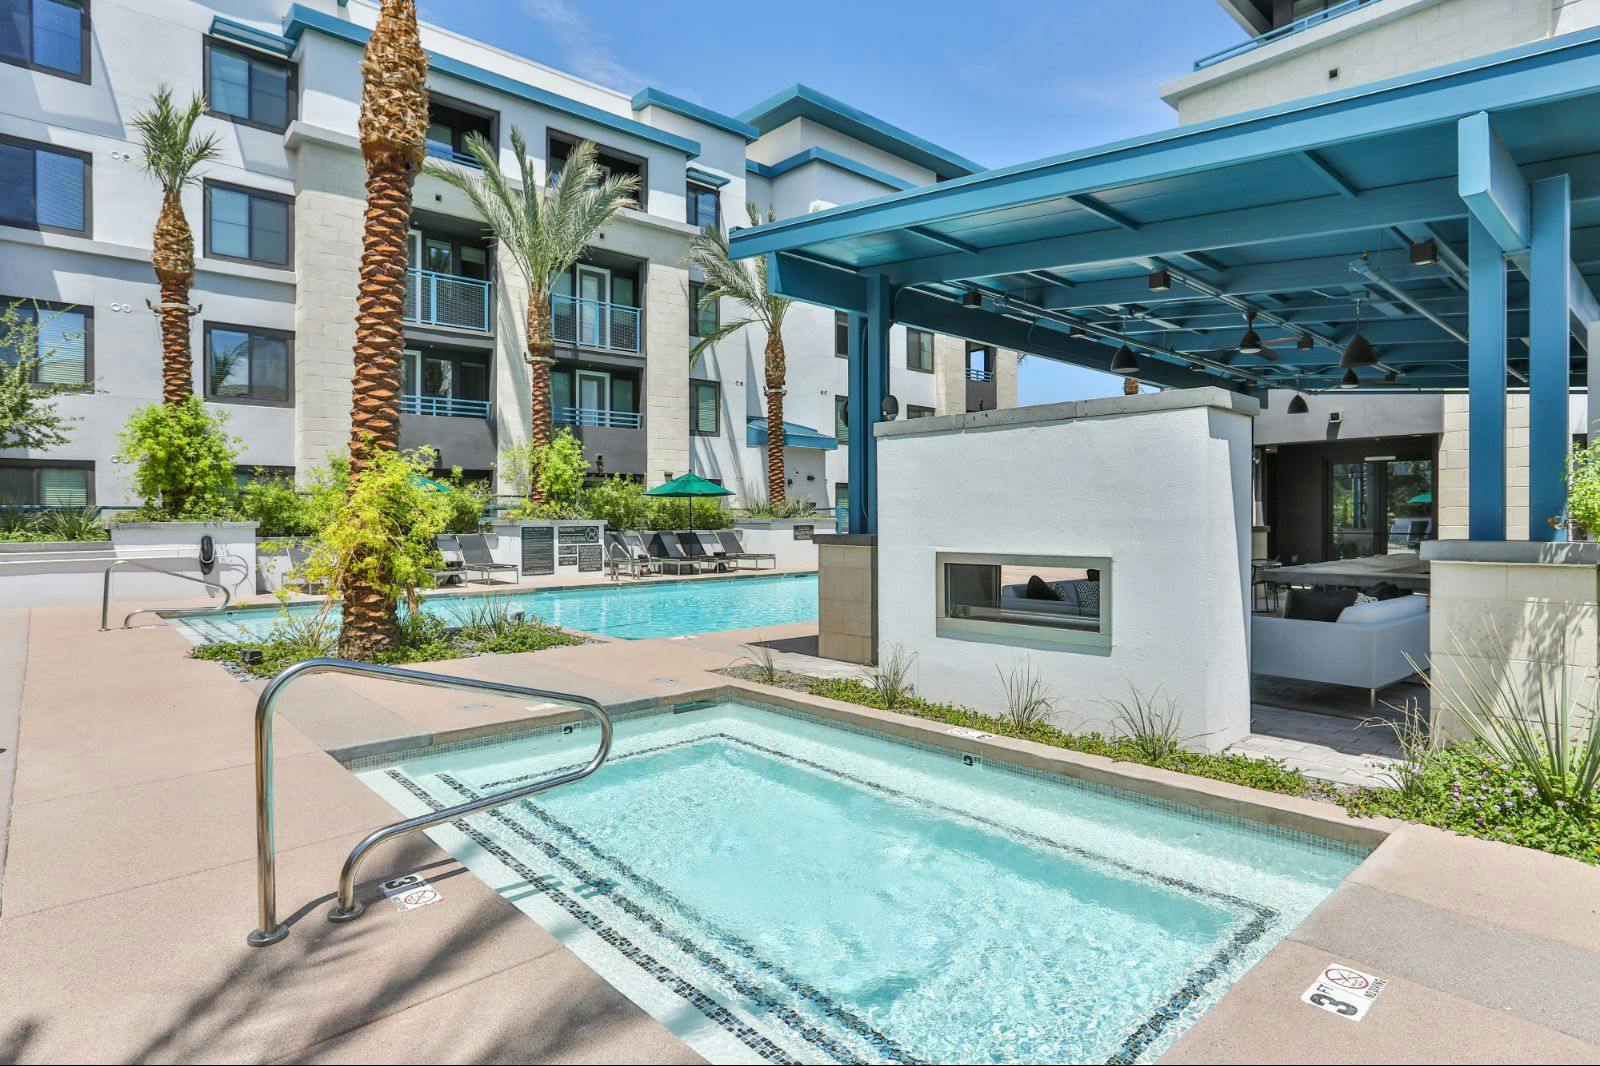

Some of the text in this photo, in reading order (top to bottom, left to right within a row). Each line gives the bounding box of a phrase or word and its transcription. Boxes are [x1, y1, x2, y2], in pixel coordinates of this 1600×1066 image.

[385, 875, 418, 889] 3
[1316, 983, 1334, 995] FT
[1309, 993, 1358, 1016] 3
